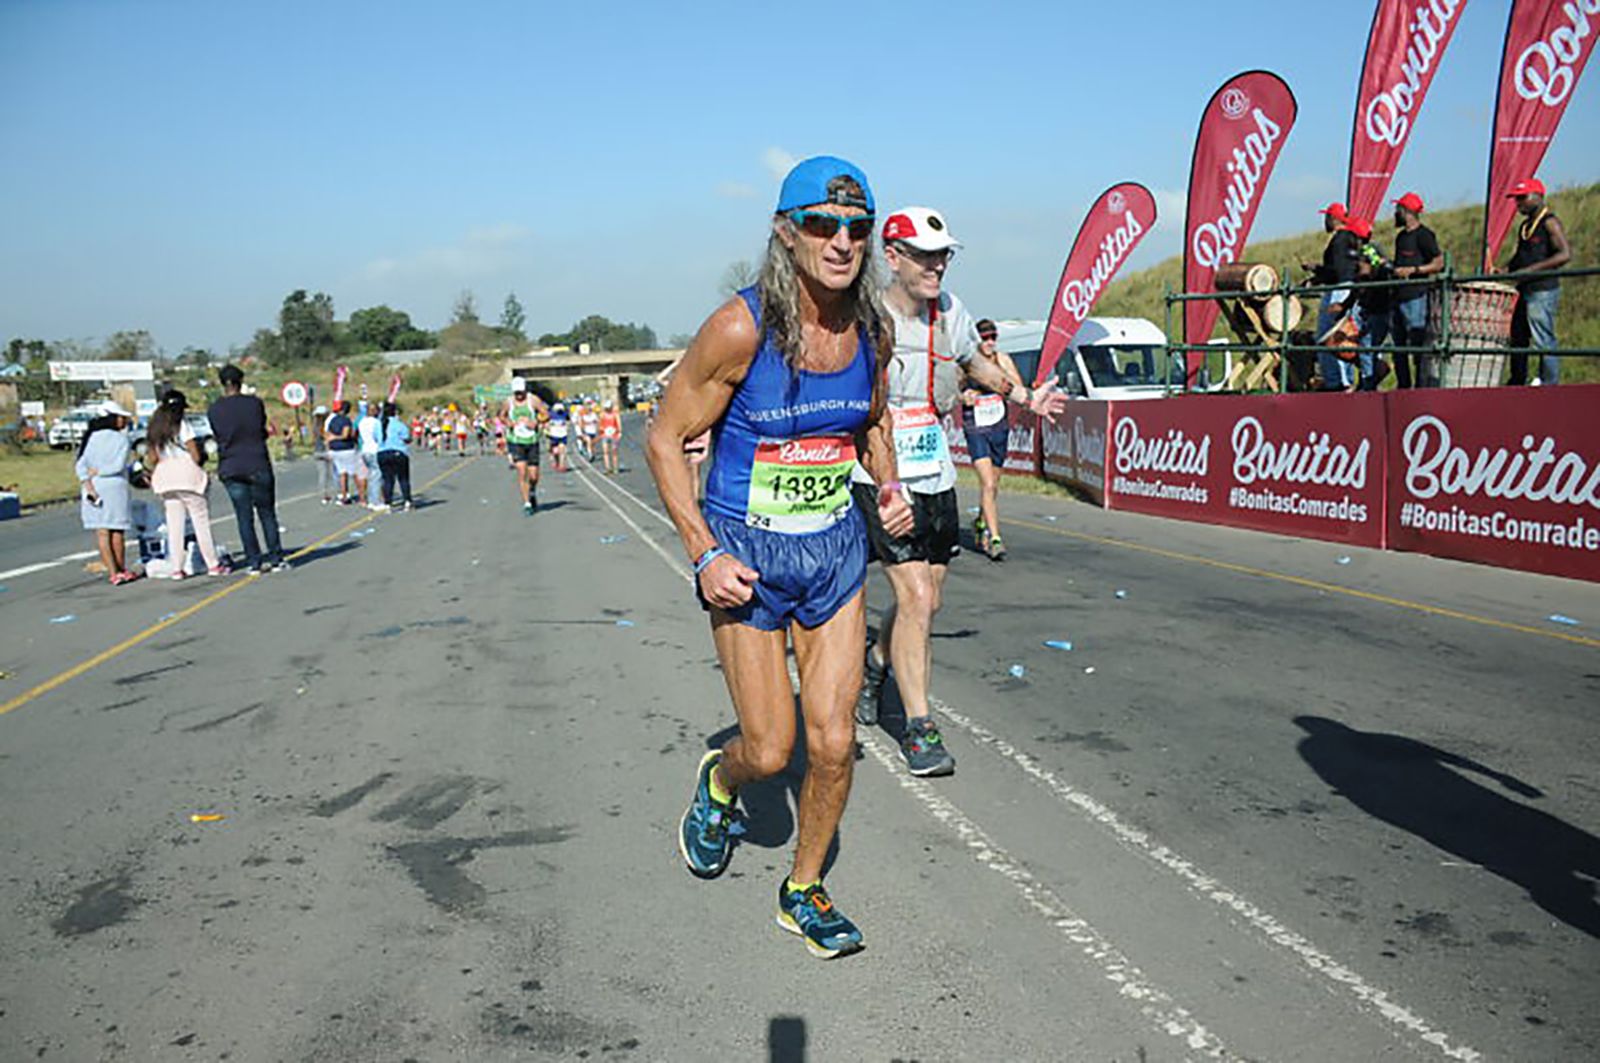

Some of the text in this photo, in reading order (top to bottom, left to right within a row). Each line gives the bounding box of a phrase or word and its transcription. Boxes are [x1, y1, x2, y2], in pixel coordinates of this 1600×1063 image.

[1193, 108, 1280, 271] Bonitas
[1062, 210, 1142, 321] Bonitas
[1114, 416, 1210, 476] Bonitas
[1231, 416, 1370, 489] Bonitas
[750, 513, 771, 528] 24
[1113, 478, 1208, 504] #BonitasComrades
[1229, 487, 1368, 523] #BonitasComrades
